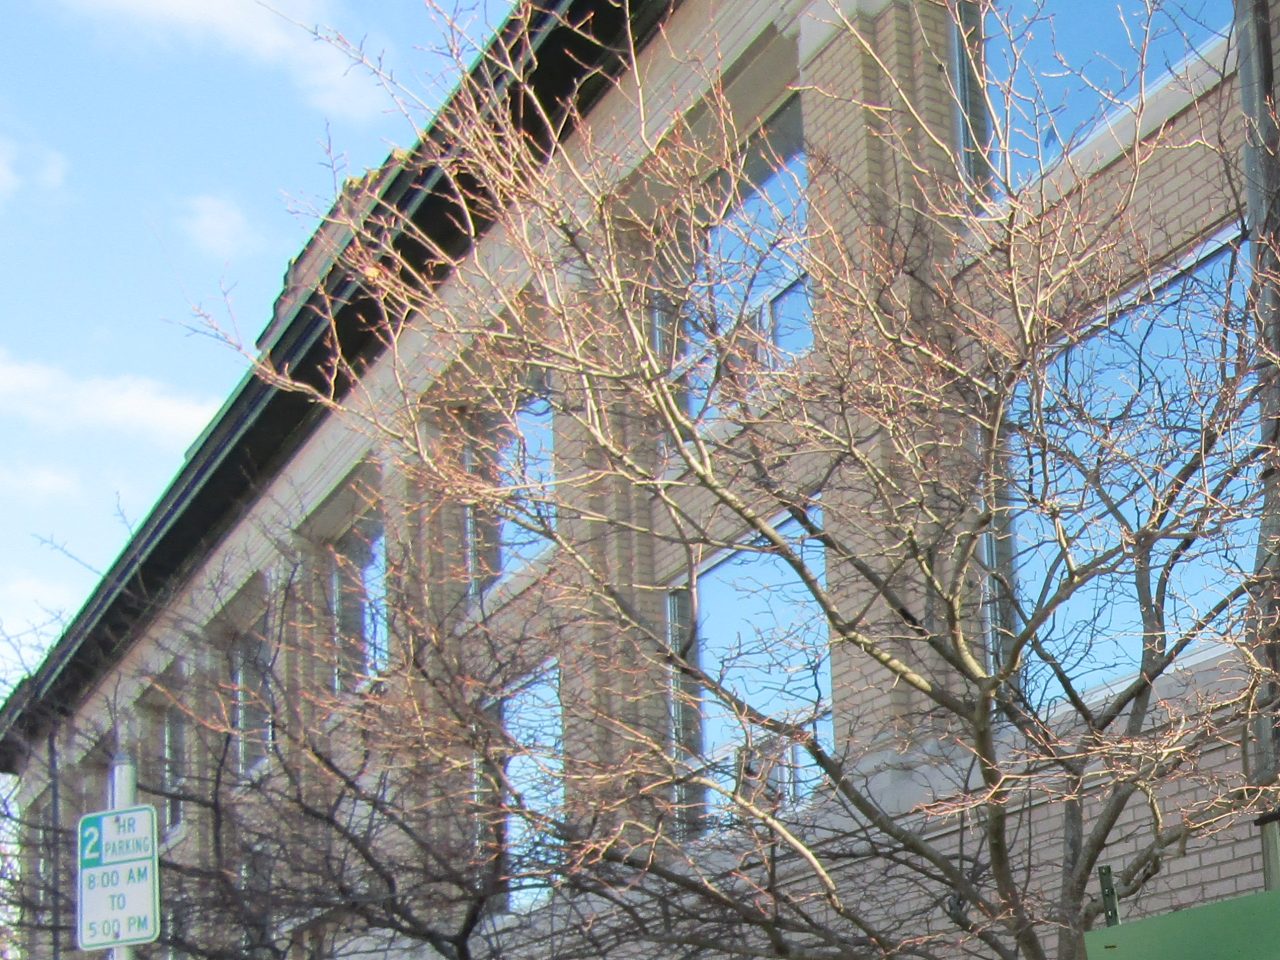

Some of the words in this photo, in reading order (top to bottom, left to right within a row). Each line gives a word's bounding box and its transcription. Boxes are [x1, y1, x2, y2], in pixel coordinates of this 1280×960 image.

[117, 817, 136, 833] HR
[83, 827, 99, 859] 2
[104, 837, 150, 856] PARKING
[127, 866, 148, 885] AM
[109, 894, 126, 911] TO
[128, 915, 148, 934] PM
